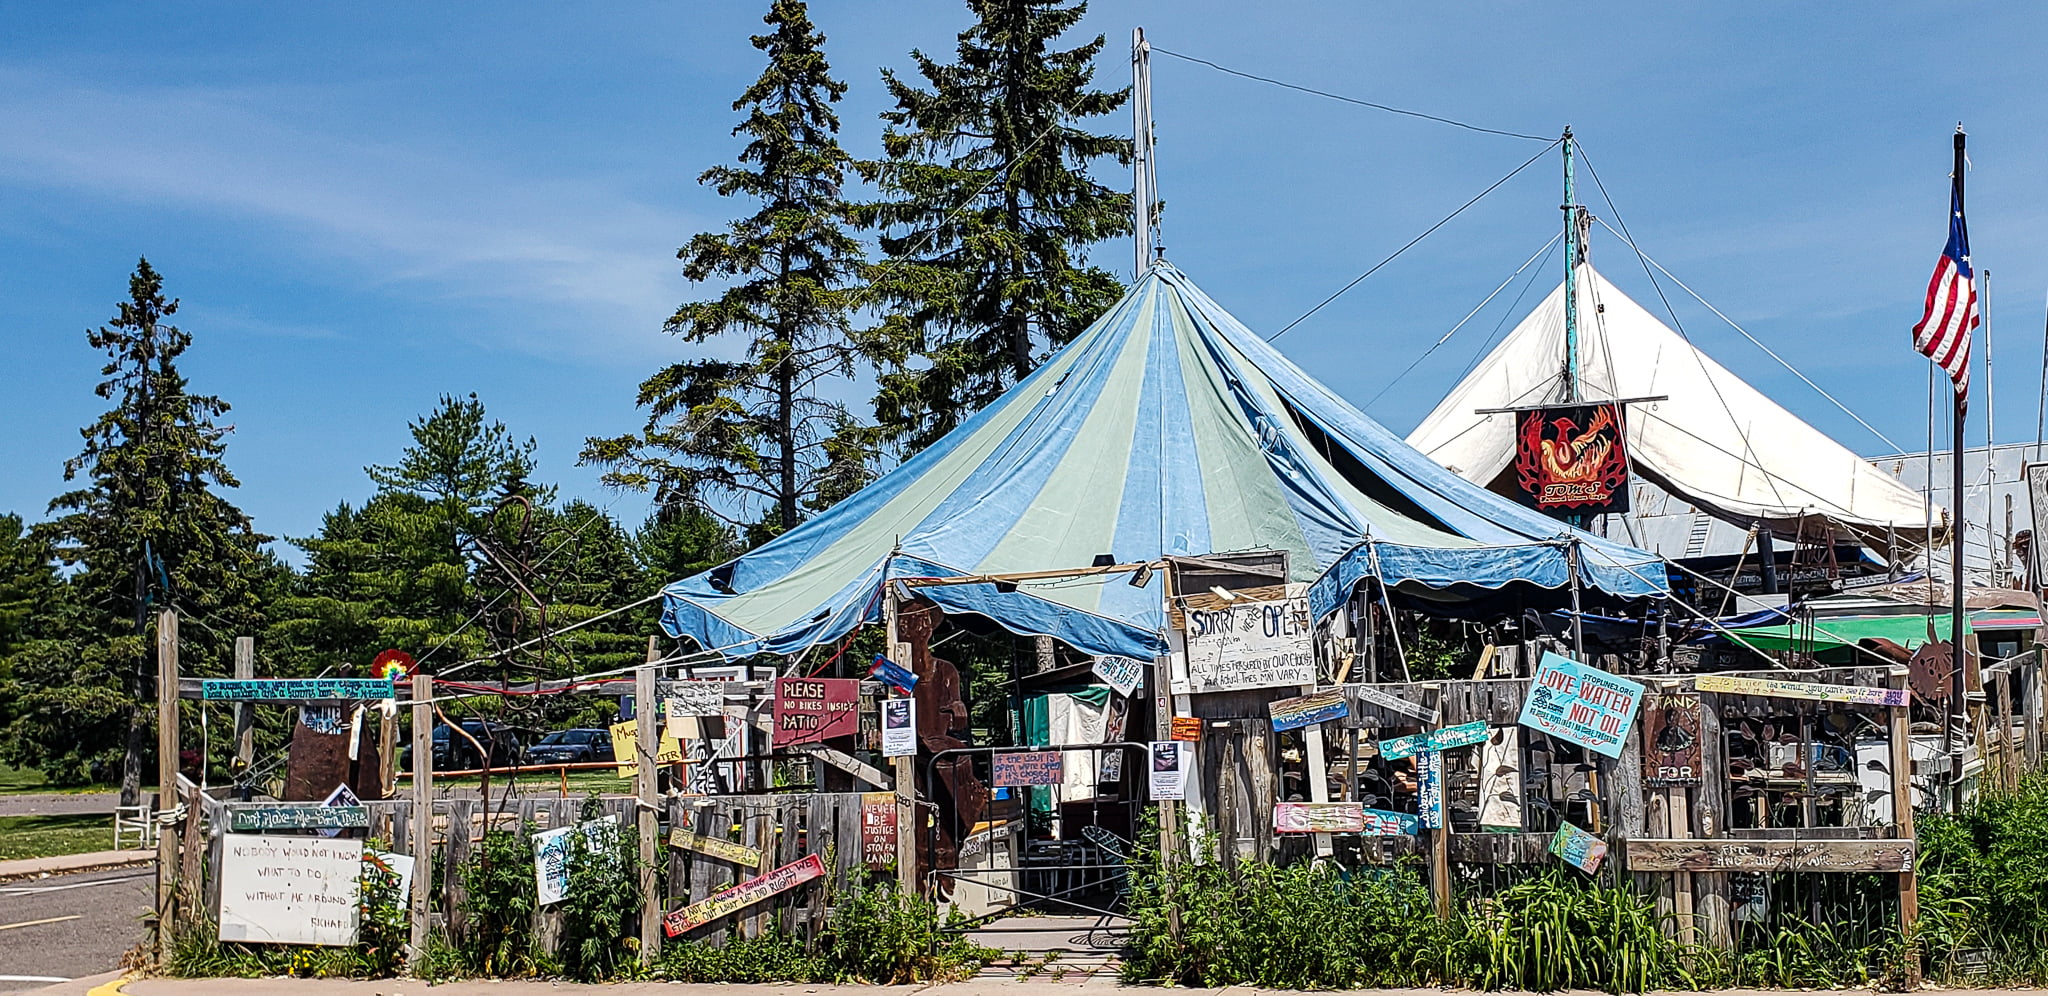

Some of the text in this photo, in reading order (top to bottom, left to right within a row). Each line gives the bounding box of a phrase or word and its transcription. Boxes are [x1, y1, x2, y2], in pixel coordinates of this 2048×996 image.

[1545, 482, 1601, 497] TOM'S
[1191, 607, 1236, 638] SORRY
[1262, 600, 1309, 638] OPEN
[1191, 664, 1208, 674] ALL
[1272, 653, 1290, 668] OUR
[1275, 666, 1302, 681] VARY
[783, 682, 824, 698] PLEASE
[1538, 667, 1632, 718] LOVE WATER
[1582, 673, 1635, 697] STOPLINE3.ORG
[784, 700, 795, 710] NO
[799, 701, 822, 710] BIKES
[783, 714, 818, 729] PATIO
[1569, 703, 1601, 727] NOT
[1600, 714, 1622, 737] OIL
[1658, 766, 1692, 778] FOR
[865, 804, 896, 814] NEVER
[294, 810, 311, 828] Me
[874, 815, 887, 826] BE
[865, 825, 895, 835] JUSTICE
[874, 835, 887, 843] ON
[233, 846, 278, 858] NOBODY
[283, 847, 308, 859] WOULD
[312, 848, 328, 858] NOT
[866, 843, 896, 853] STOLEN
[866, 852, 895, 864] LAND
[257, 867, 322, 879] WHAT TO DO
[687, 905, 702, 917] NOT
[743, 878, 766, 893] THING
[768, 867, 794, 881] UNTIL
[795, 860, 813, 872] WE
[245, 890, 347, 906] WITHOUT ME AROUND
[671, 916, 700, 933] FIGURE
[702, 909, 718, 921] OUT
[719, 901, 739, 914] WHAT
[741, 894, 752, 906] WE
[754, 888, 769, 899] DID
[310, 917, 350, 929] RICHARD
